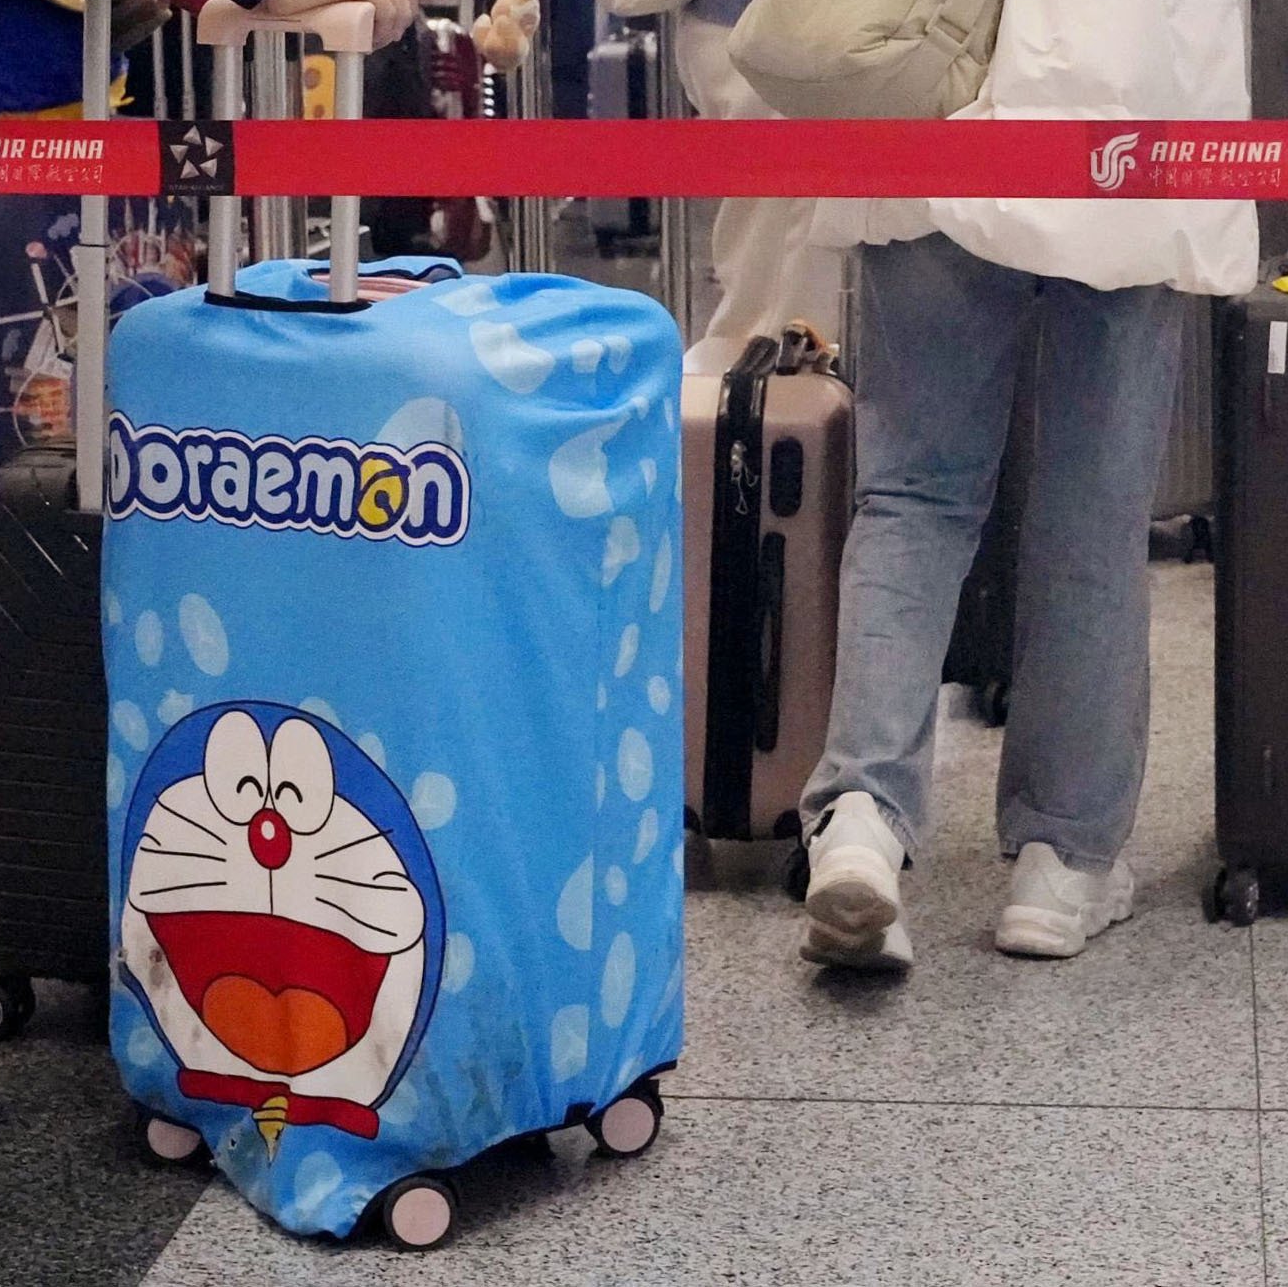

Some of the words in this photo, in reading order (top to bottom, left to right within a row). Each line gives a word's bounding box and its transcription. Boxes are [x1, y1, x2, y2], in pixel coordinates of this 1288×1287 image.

[30, 138, 104, 159] CHINA
[1150, 141, 1196, 162] AIR
[1201, 141, 1282, 163] CHINA
